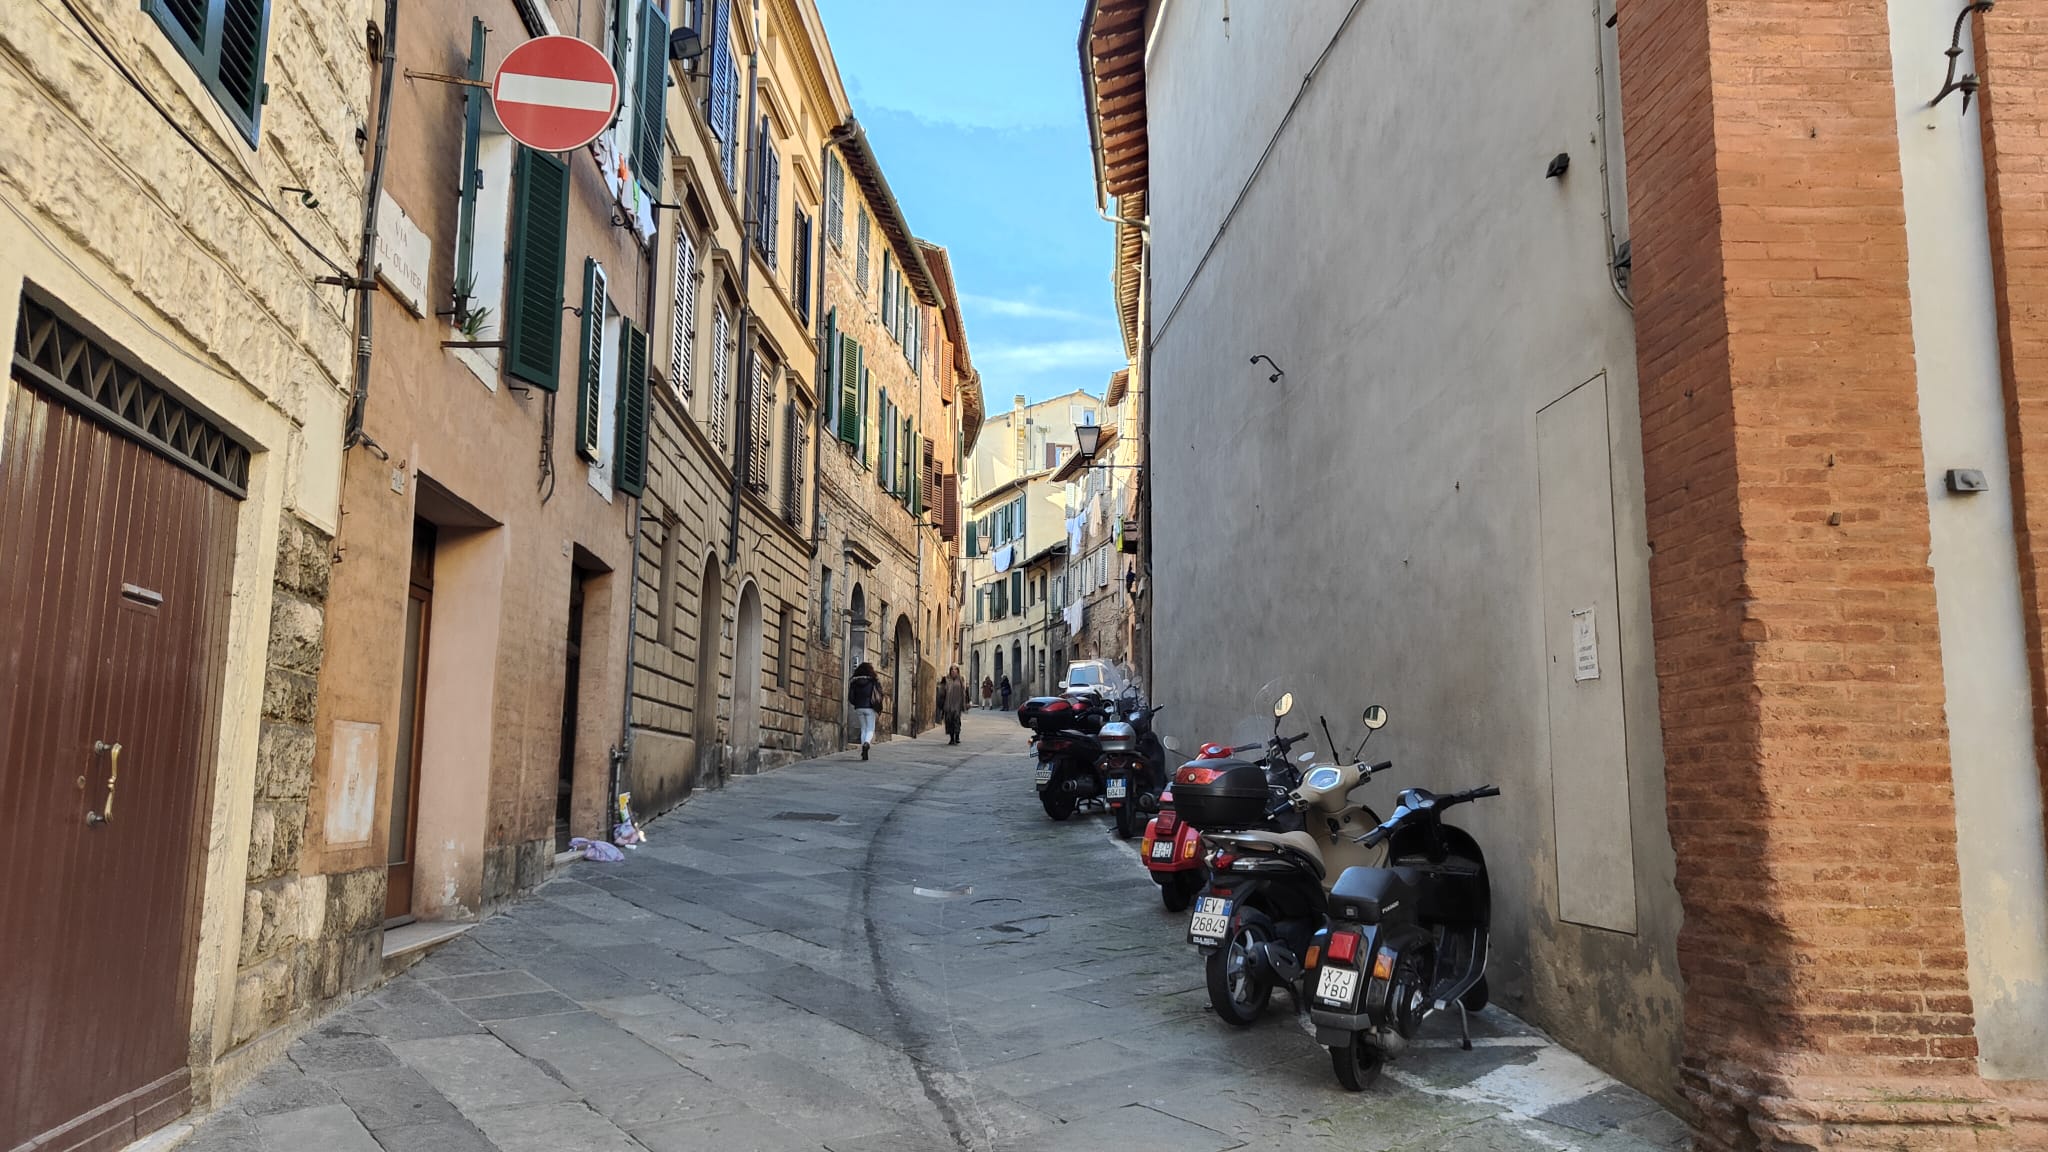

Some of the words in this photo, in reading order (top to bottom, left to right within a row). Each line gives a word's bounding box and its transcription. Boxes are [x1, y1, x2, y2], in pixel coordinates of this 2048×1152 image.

[395, 222, 408, 247] VIA
[1204, 898, 1218, 913] EV
[1193, 916, 1226, 934] 26849
[1325, 969, 1351, 985] X7J
[1323, 982, 1348, 999] YBD
